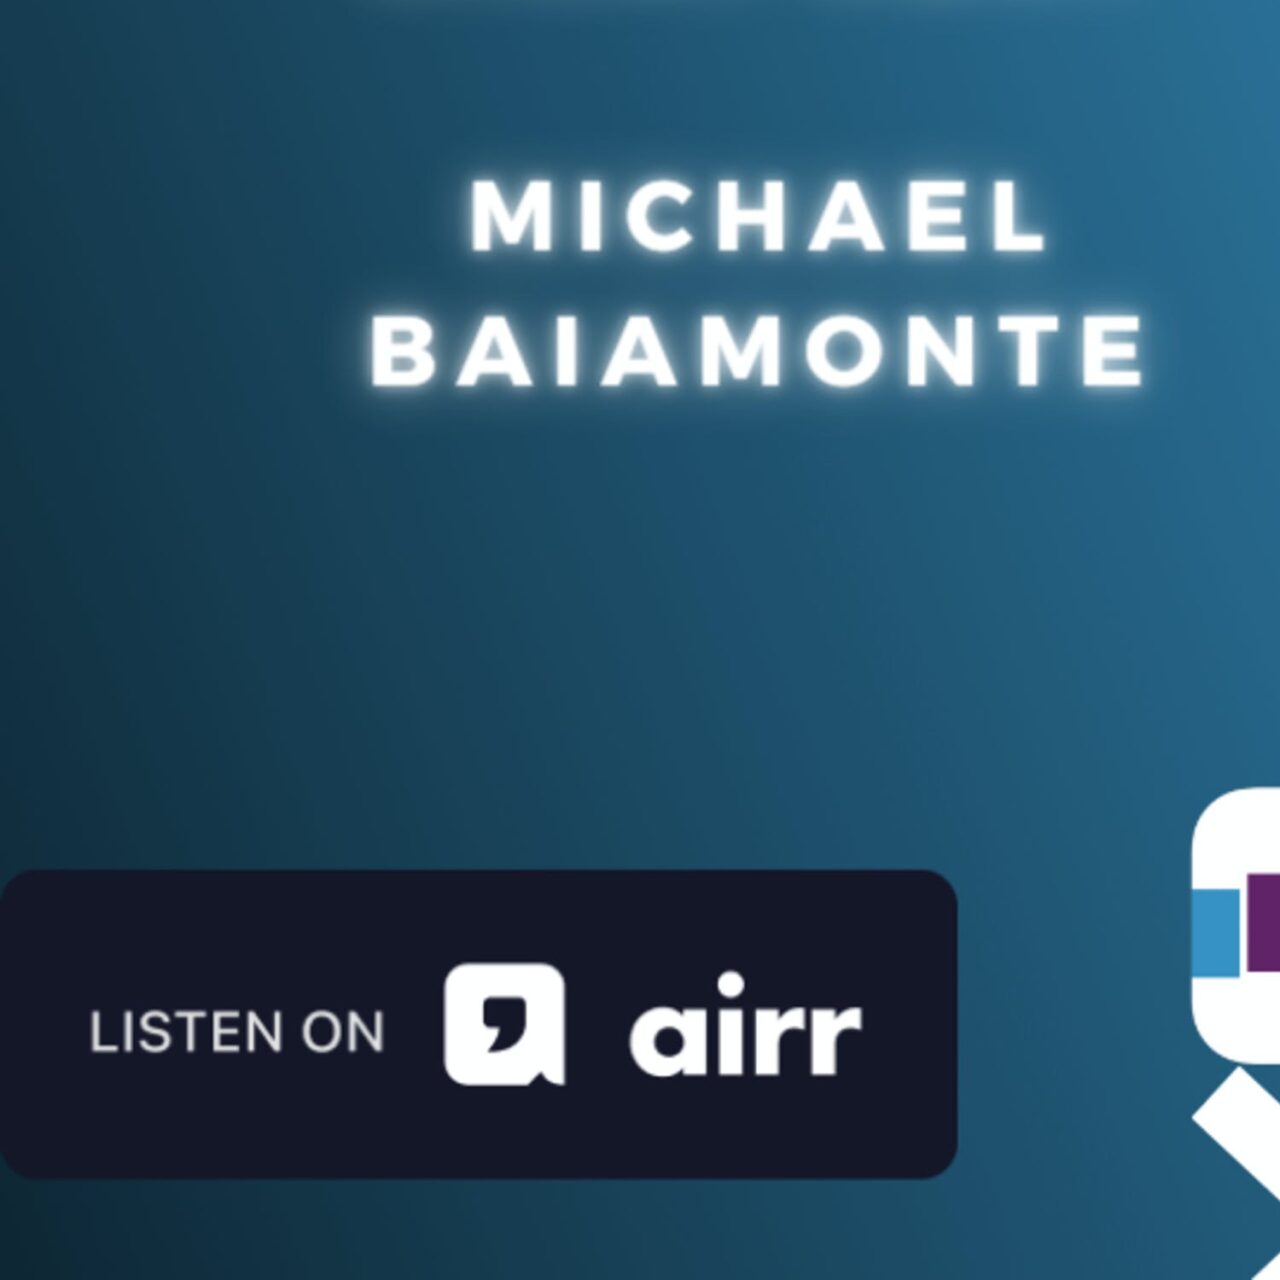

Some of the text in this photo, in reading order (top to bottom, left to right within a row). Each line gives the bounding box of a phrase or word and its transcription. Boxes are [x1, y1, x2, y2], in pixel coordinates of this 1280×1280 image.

[472, 179, 1044, 253] MICHAEL
[372, 314, 1143, 388] BAIAMONTE
[91, 970, 863, 1078] LISTEN ON airr
